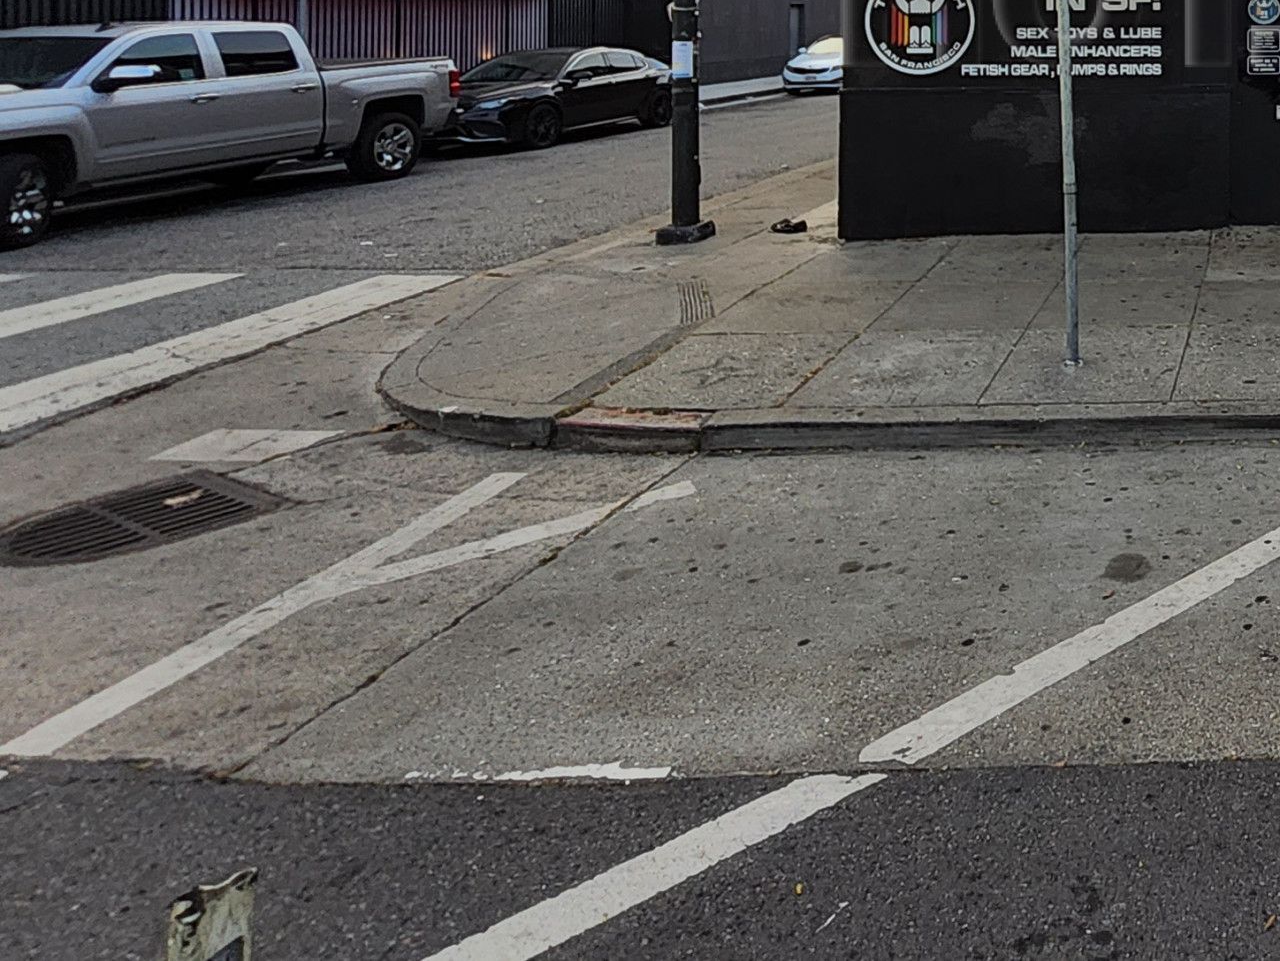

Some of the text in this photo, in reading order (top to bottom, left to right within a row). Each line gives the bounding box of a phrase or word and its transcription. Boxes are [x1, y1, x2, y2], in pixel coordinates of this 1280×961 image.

[1016, 27, 1162, 39] SEX OYS & LUBE
[879, 41, 962, 69] SAN FRANCISCO
[1010, 45, 1162, 57] MALE NHANCERS
[961, 63, 1009, 76] FETISH
[1057, 63, 1106, 76] MPS
[1107, 63, 1119, 76] &
[1120, 63, 1162, 76] RINGS
